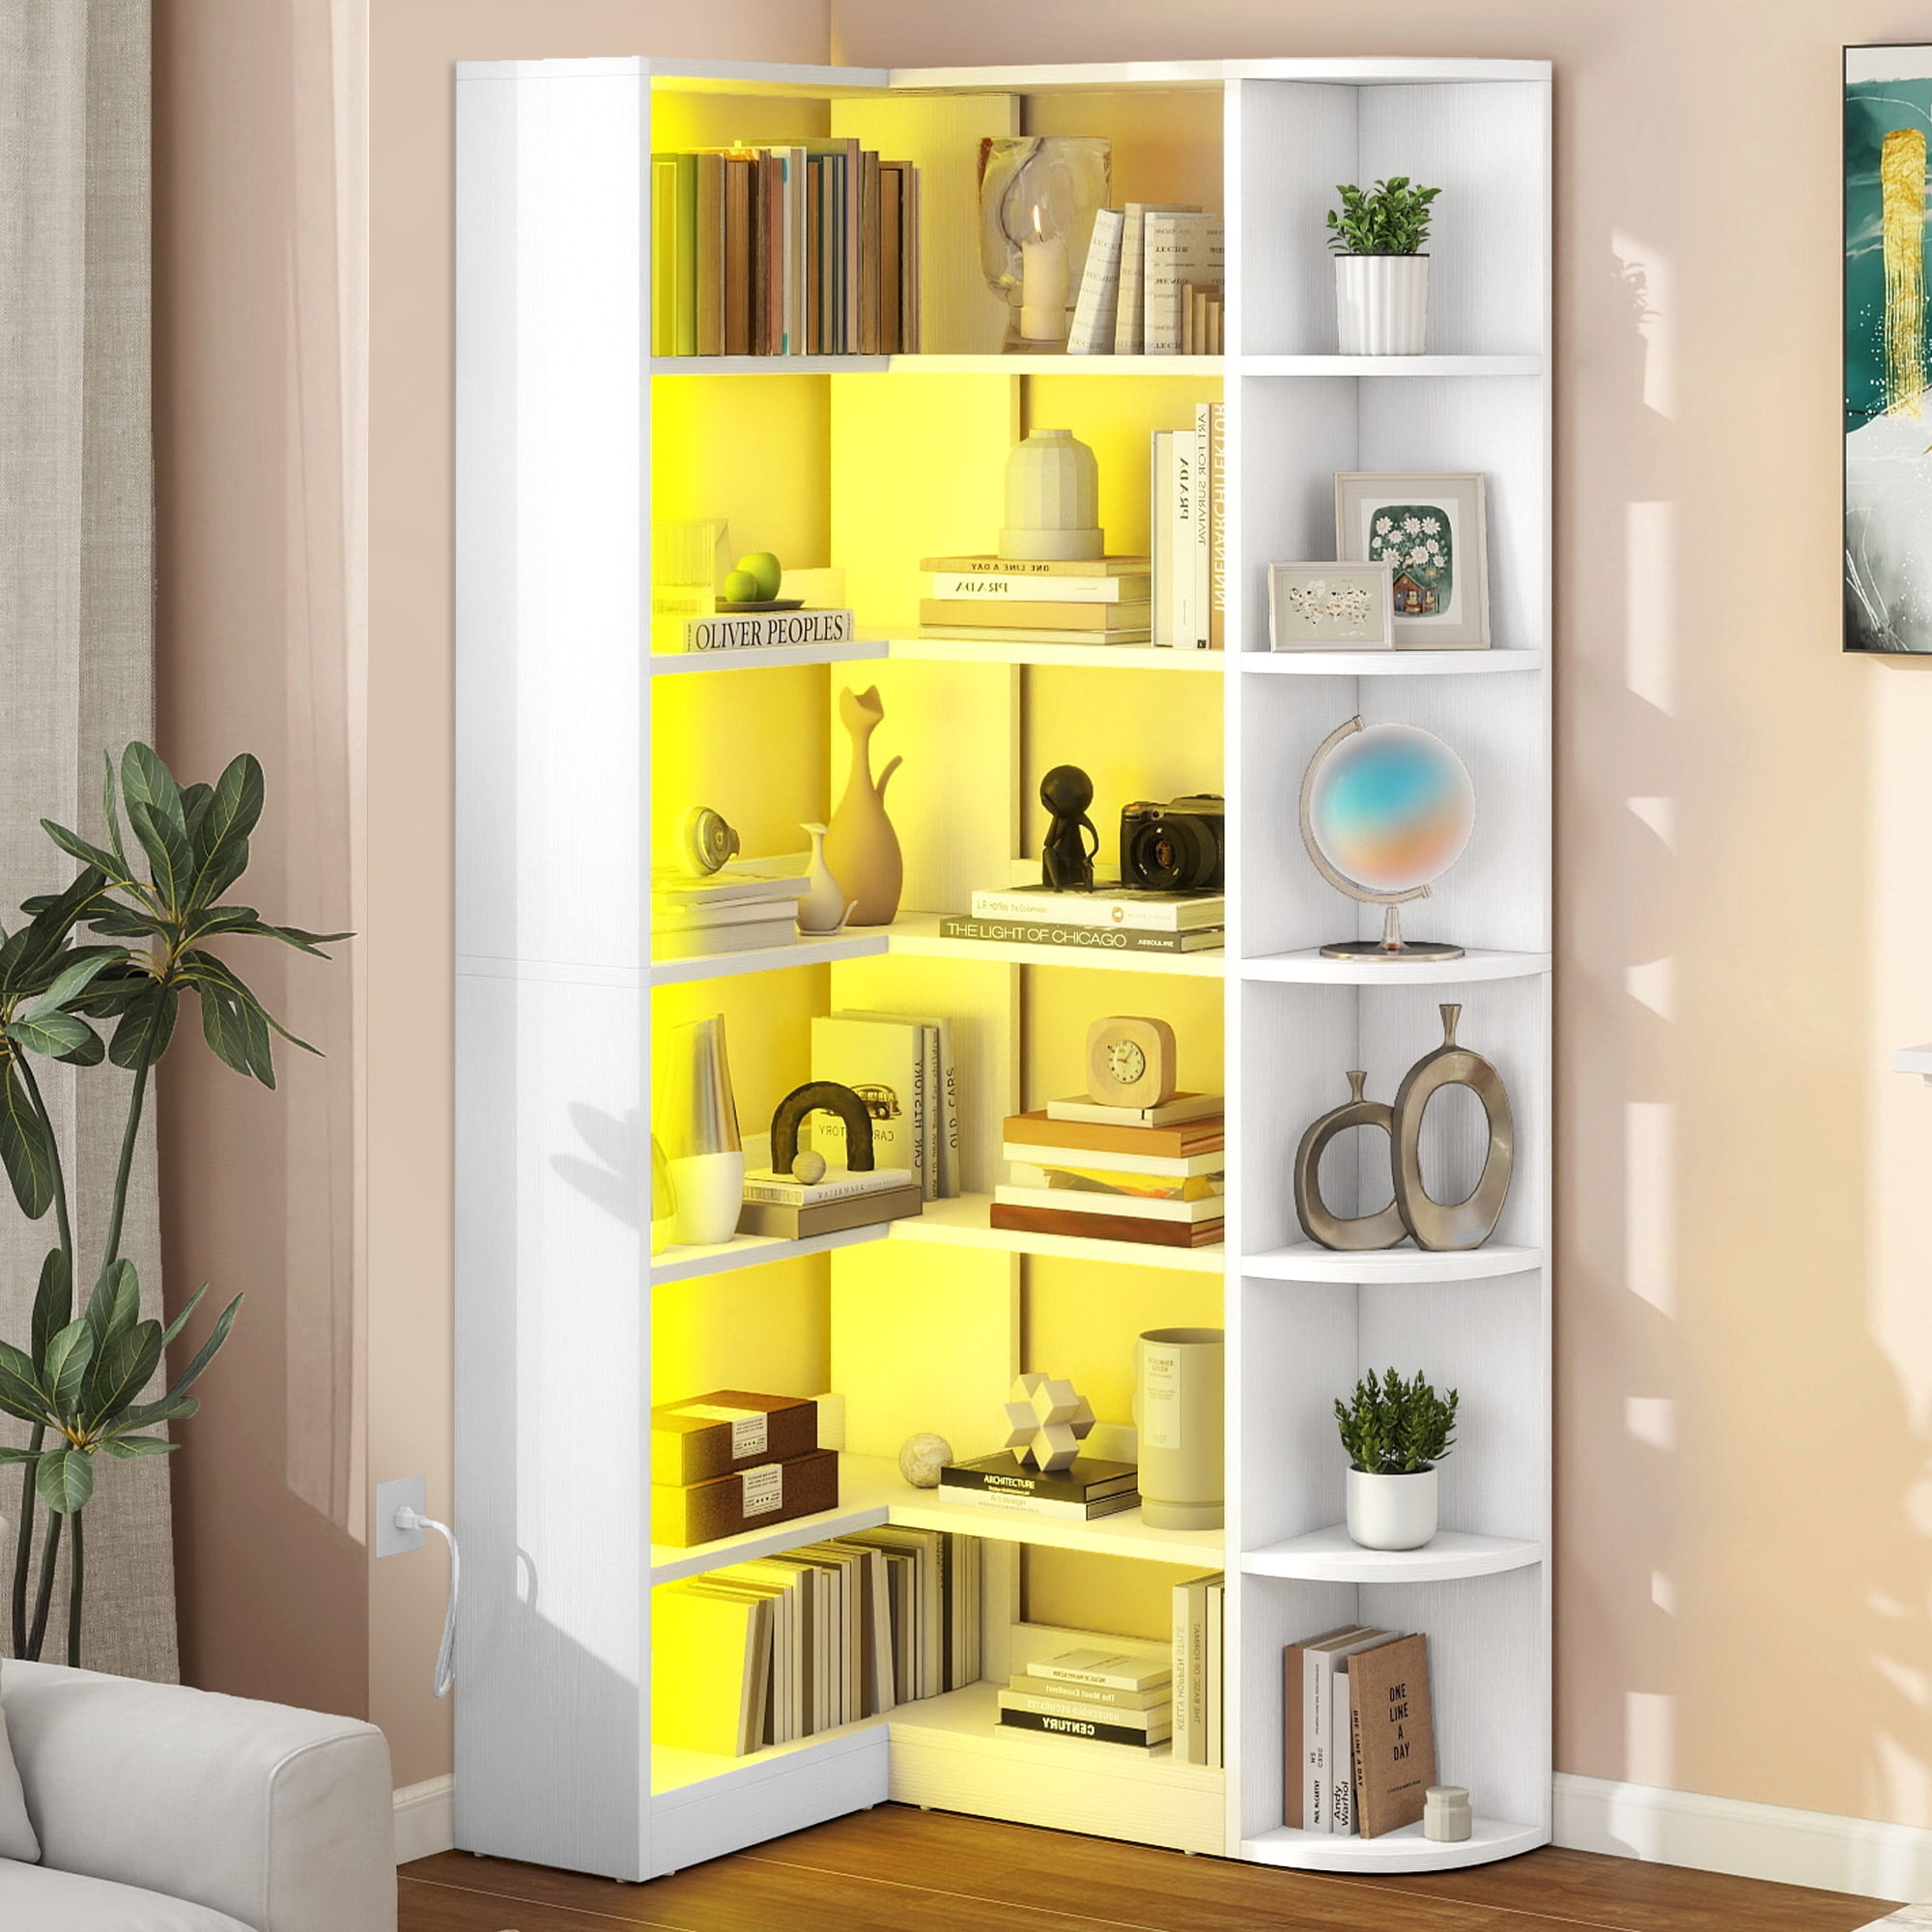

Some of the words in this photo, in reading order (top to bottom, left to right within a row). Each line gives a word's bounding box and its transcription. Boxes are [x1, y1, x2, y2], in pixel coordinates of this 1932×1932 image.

[696, 620, 761, 651] OLIVER
[767, 614, 843, 645] PEOPLES
[947, 922, 977, 938] THE
[980, 923, 1024, 943] LIGHT
[1027, 927, 1051, 944] OF
[1051, 928, 1127, 949] CHICAGO
[983, 1474, 1036, 1490] ARCHITECTURE
[1389, 1683, 1406, 1702] ONE
[1389, 1703, 1408, 1722] LINE
[1397, 1724, 1404, 1740] A
[1393, 1742, 1410, 1761] DAY
[1333, 1785, 1343, 1820] Andy
